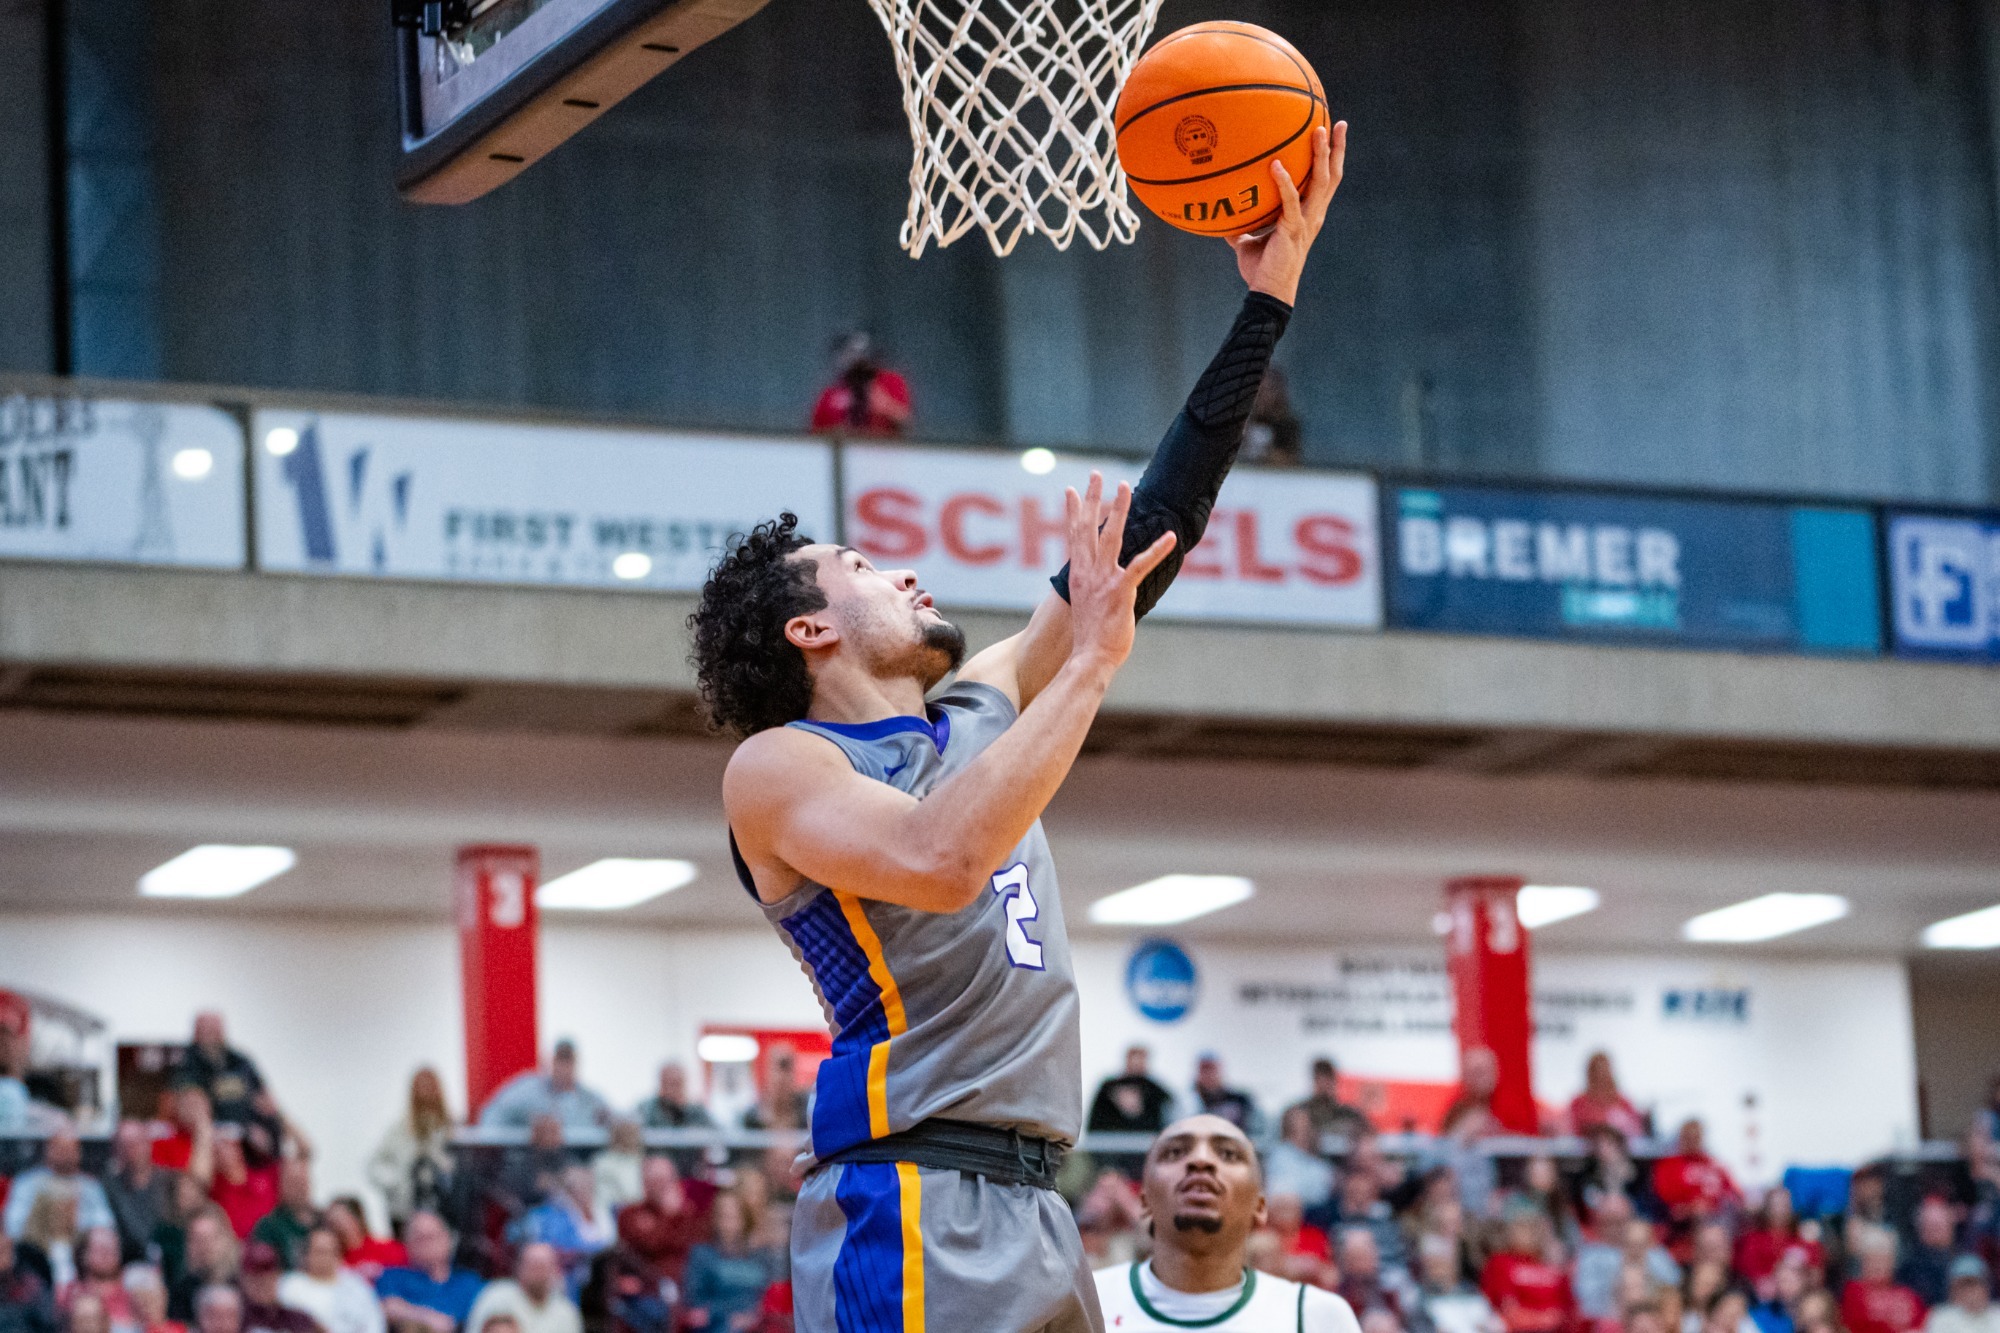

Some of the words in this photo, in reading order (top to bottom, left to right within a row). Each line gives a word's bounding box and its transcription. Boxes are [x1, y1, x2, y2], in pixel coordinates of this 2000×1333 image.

[1183, 184, 1259, 221] EVO
[443, 508, 576, 548] FIRST
[855, 486, 1364, 588] SCHELS
[1400, 515, 1680, 588] BREMER
[990, 861, 1046, 972] 2
